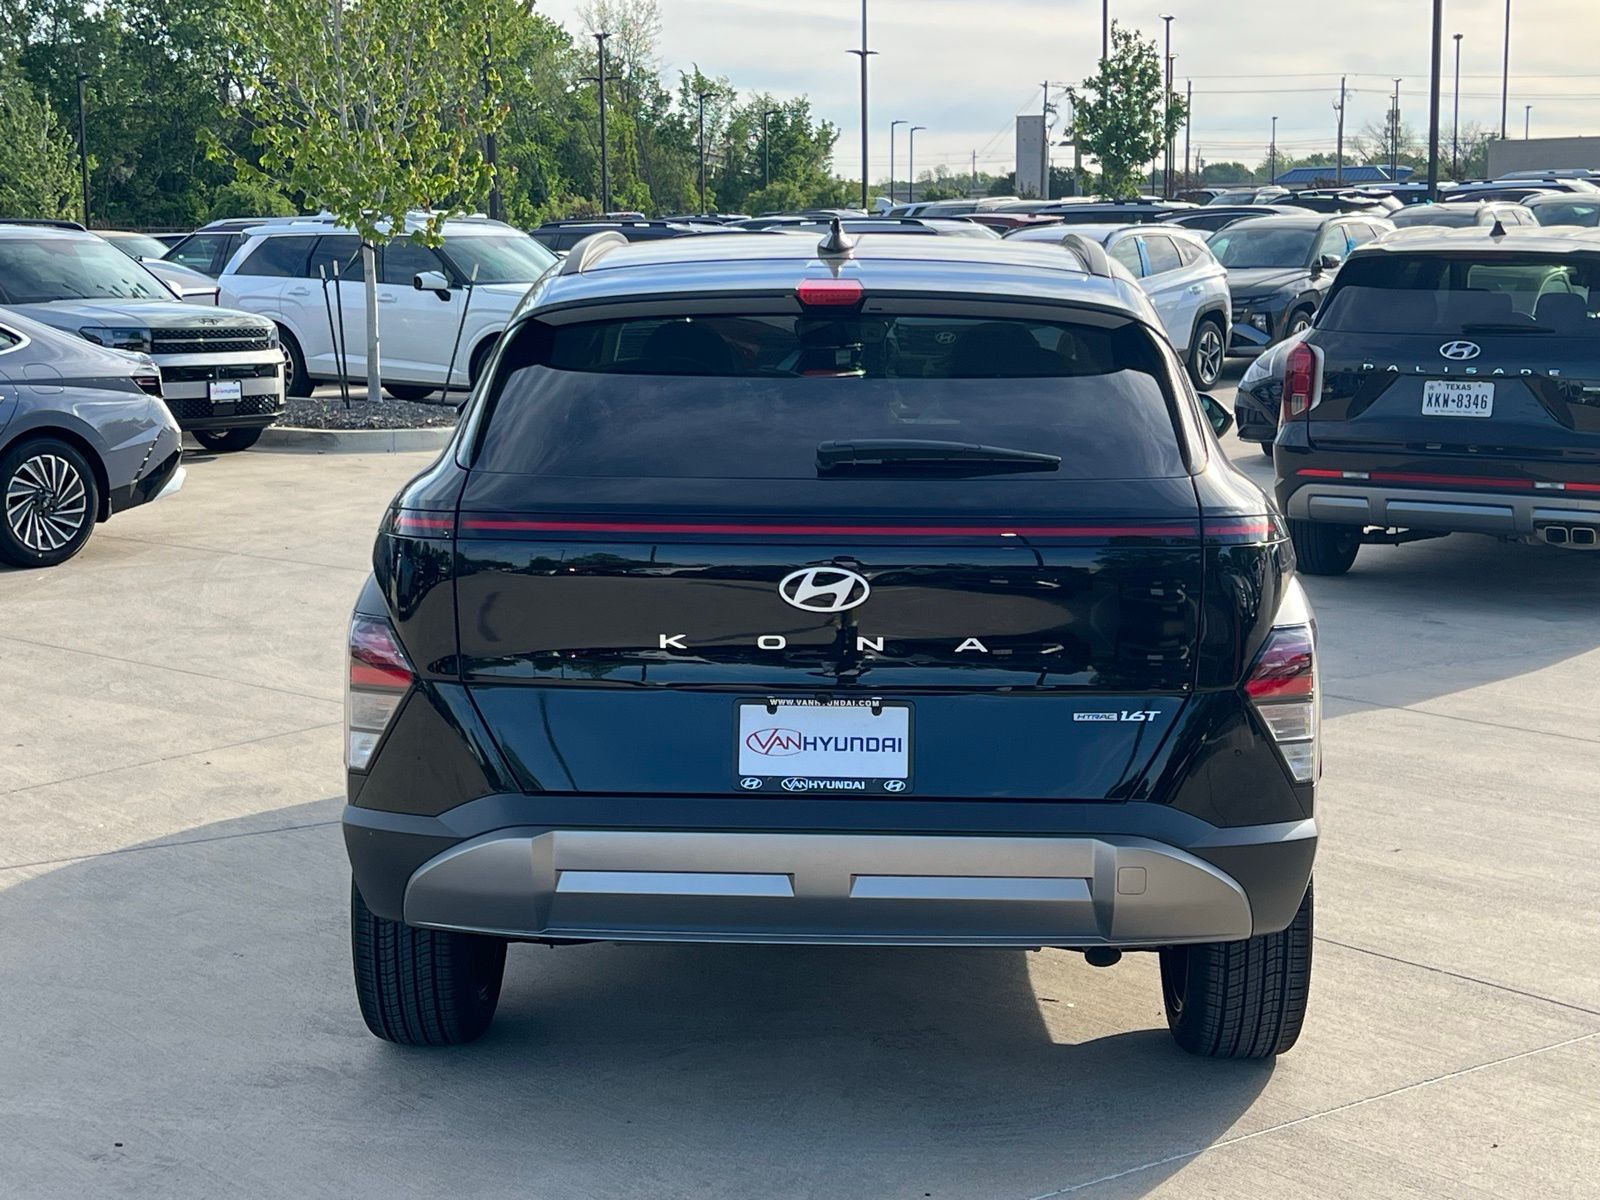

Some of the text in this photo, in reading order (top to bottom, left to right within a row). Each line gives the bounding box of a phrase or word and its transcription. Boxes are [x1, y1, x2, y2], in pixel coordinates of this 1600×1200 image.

[1362, 363, 1561, 377] PALISADE
[1446, 383, 1472, 391] TEXAS
[659, 633, 988, 653] KONA
